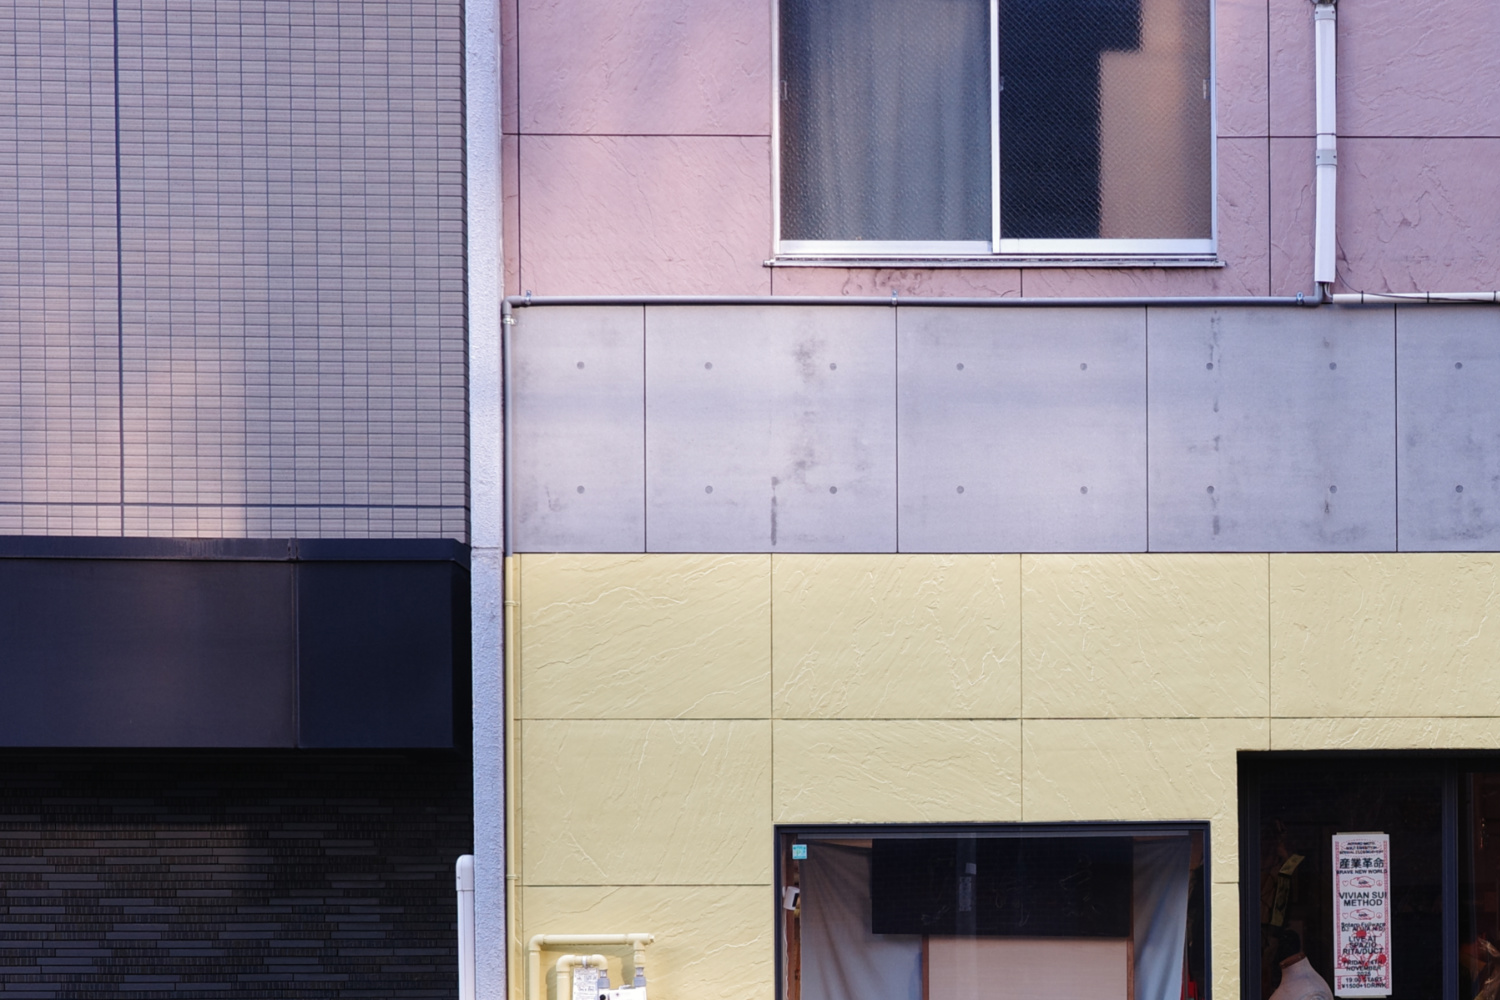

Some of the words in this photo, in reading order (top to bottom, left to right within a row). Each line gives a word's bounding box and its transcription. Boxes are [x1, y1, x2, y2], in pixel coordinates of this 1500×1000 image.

[1339, 857, 1384, 869] 産業革命
[1339, 891, 1369, 899] VIVIAN
[1343, 898, 1383, 907] METHOD
